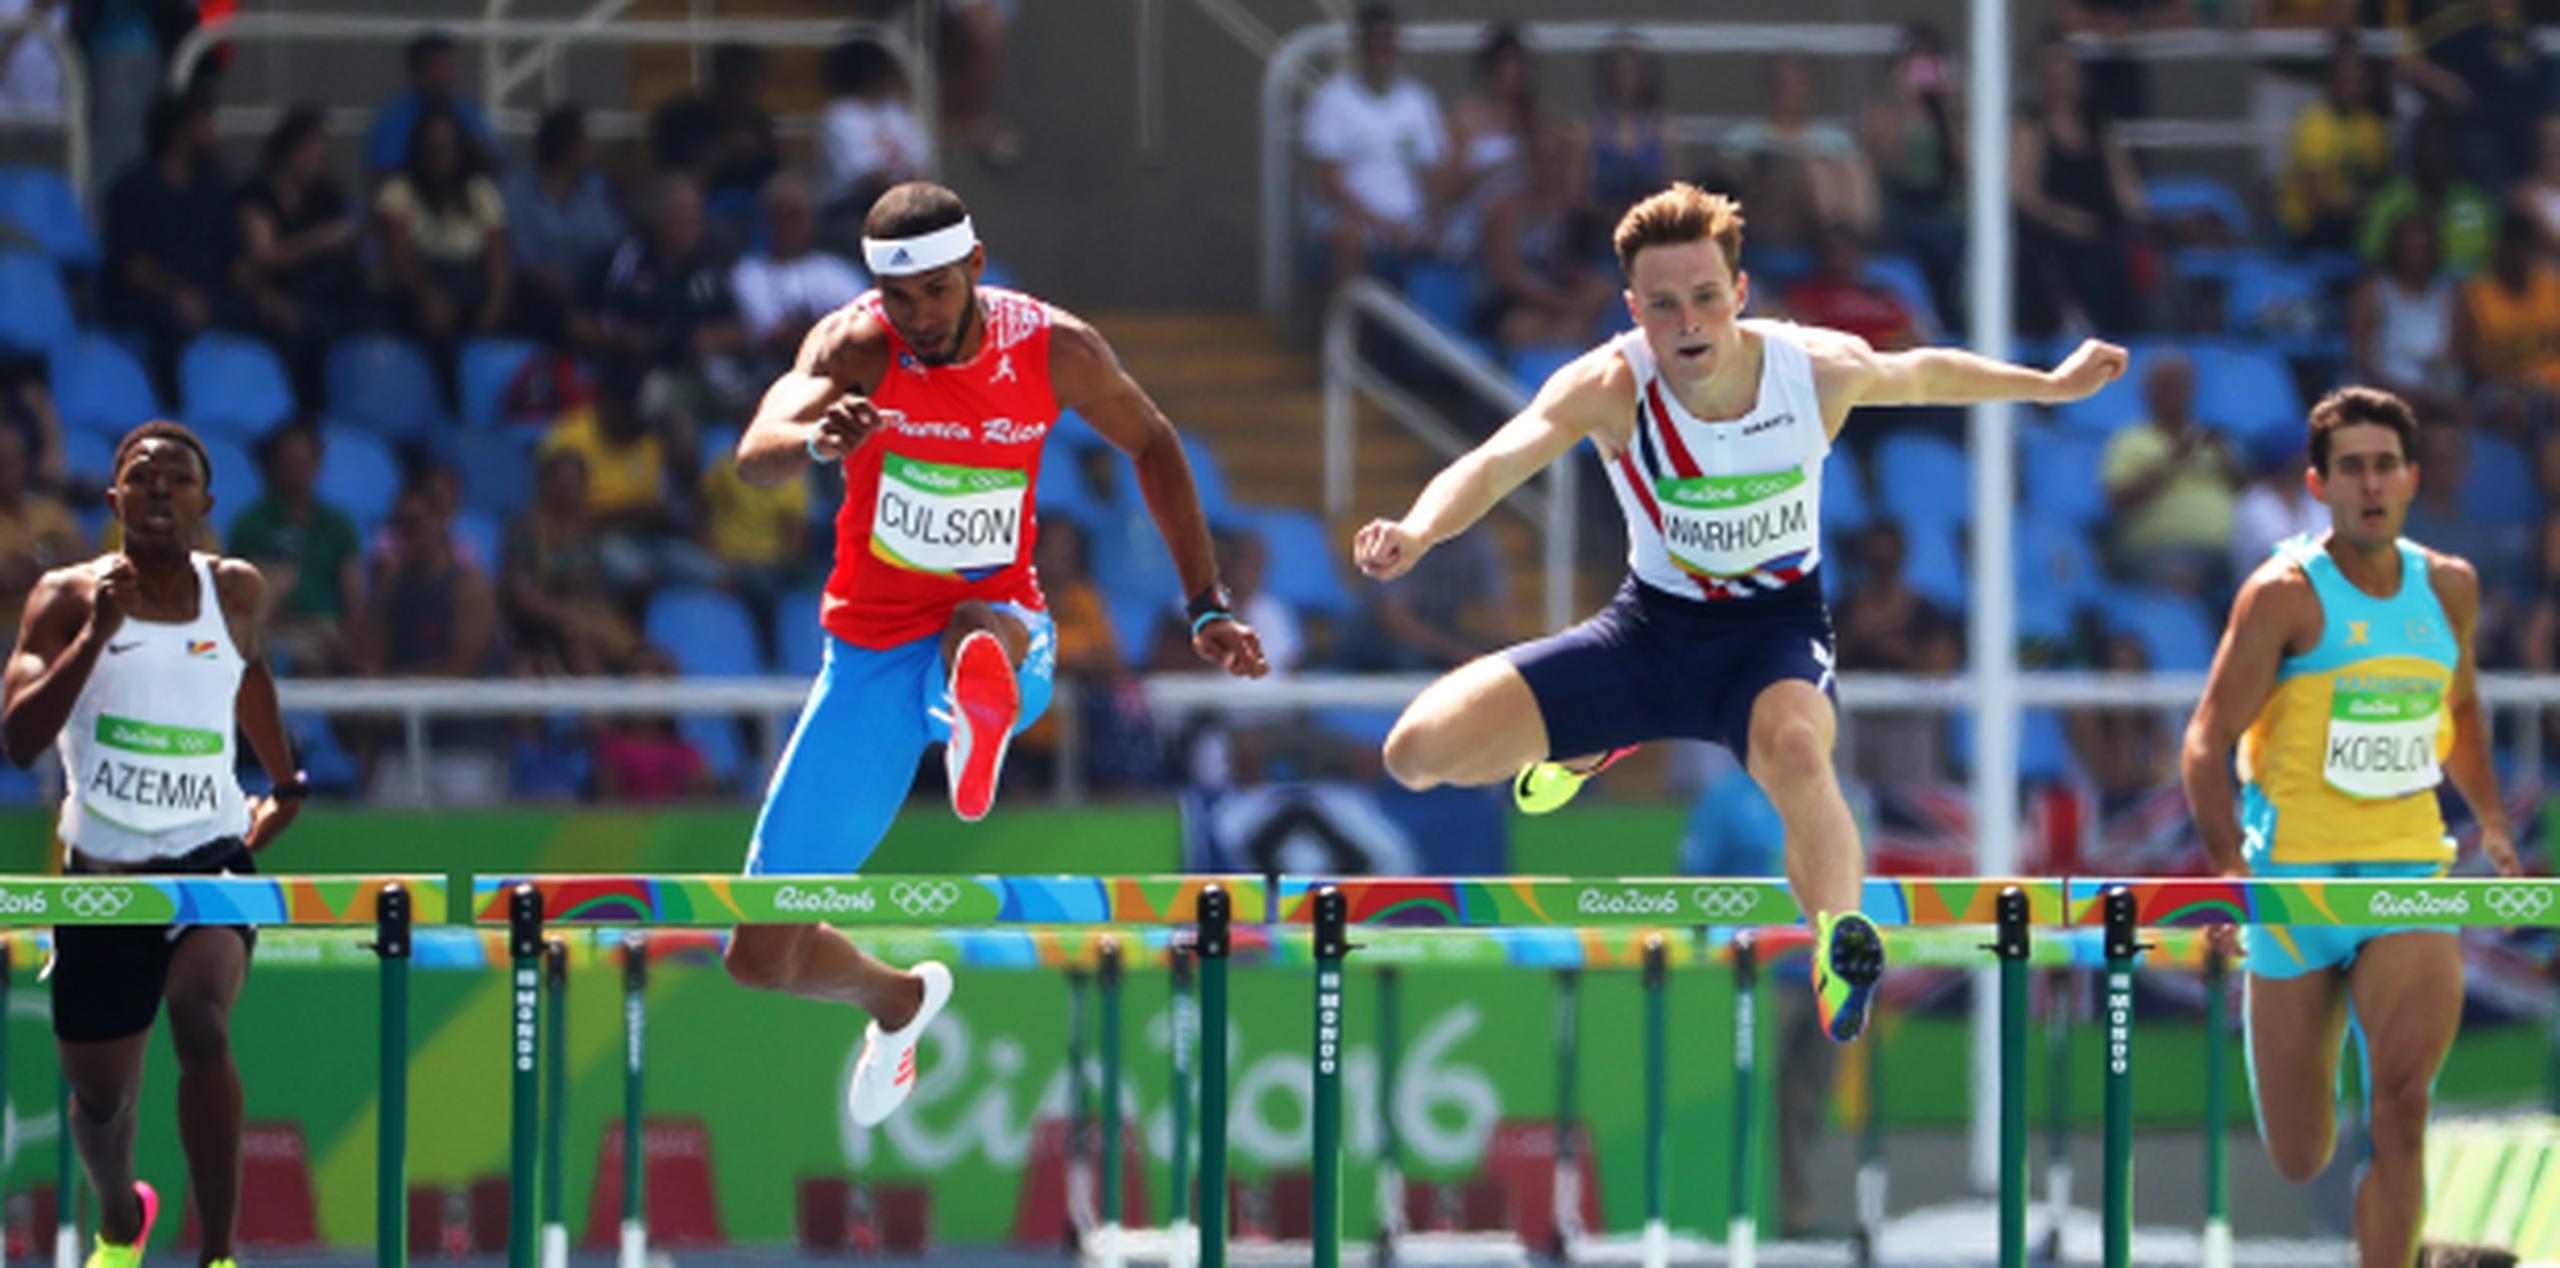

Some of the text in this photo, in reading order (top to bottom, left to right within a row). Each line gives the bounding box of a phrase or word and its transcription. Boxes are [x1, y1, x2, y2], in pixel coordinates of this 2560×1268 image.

[981, 417, 1046, 444] Rico
[881, 491, 1016, 547] CULSON
[1665, 500, 1807, 551] WARHOLM
[90, 758, 217, 811] AZEMIA
[774, 886, 876, 912] Rio2016
[1578, 887, 1680, 914] Rio2016
[2369, 889, 2470, 917] Rio2016
[516, 990, 536, 1072] MONDO
[1320, 993, 1340, 1075] MONDO
[2109, 993, 2130, 1075] MONDO
